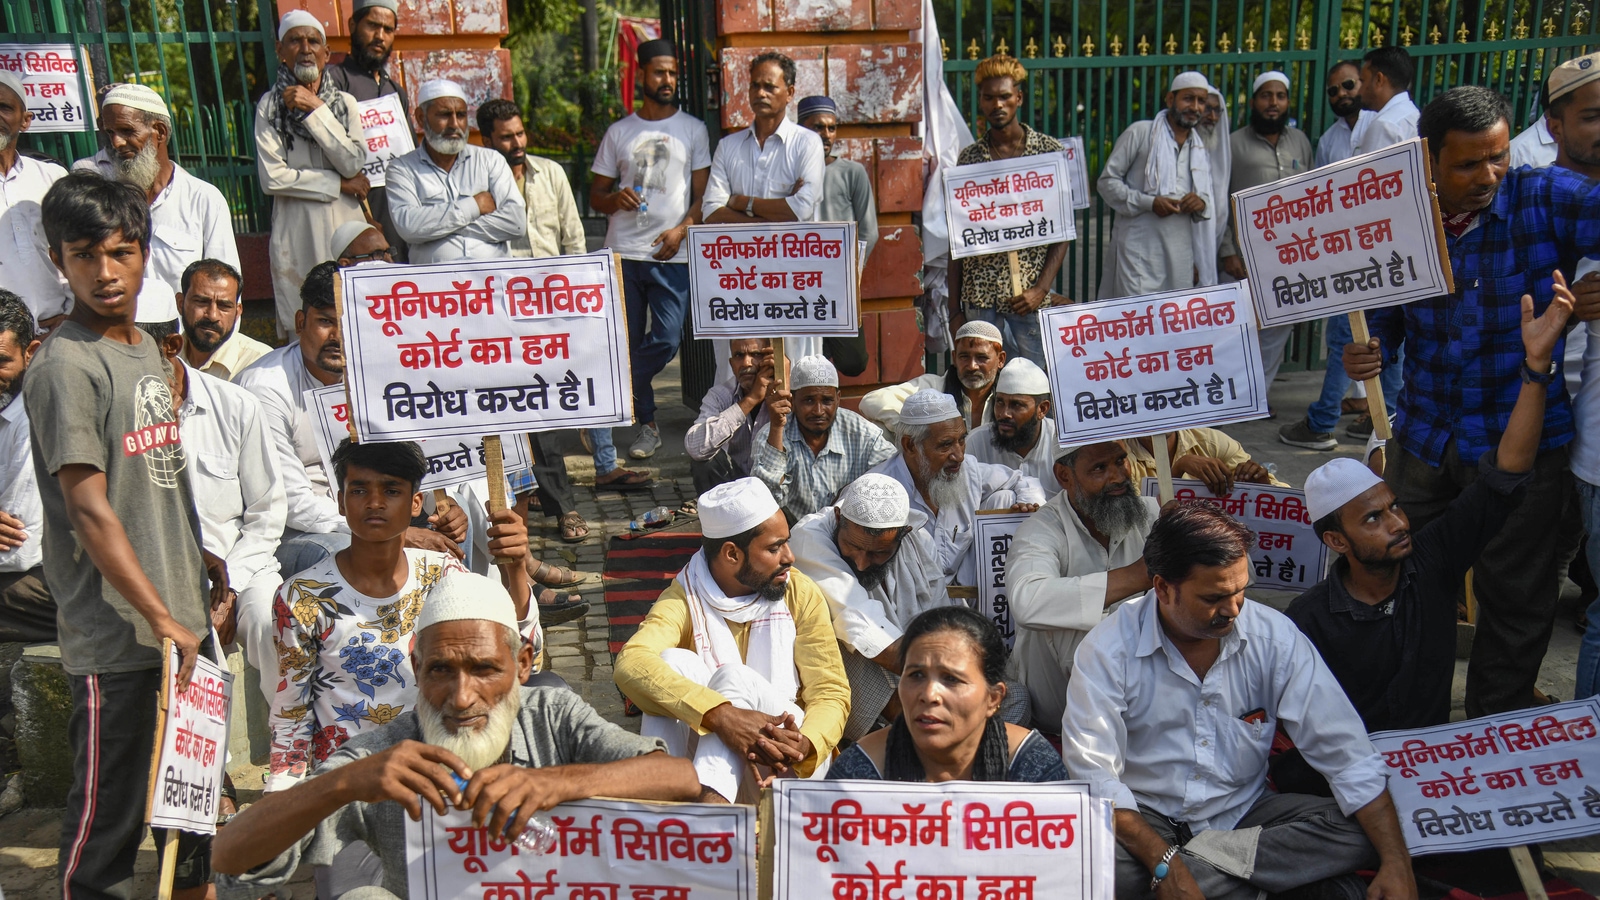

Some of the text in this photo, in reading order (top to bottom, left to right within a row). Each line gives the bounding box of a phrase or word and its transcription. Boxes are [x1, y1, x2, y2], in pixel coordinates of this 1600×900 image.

[24, 52, 79, 73] सिविल
[38, 82, 66, 98] हम
[366, 135, 389, 153] हम
[953, 171, 1054, 208] यूनिफॉर्म सिविल
[1252, 168, 1404, 241] यूनिफॉर्म सविल
[968, 199, 1044, 222] कोर्ट का हम
[701, 232, 842, 270] यूनिफॉर्म सिविल
[962, 226, 999, 248] विरोध
[1002, 220, 1034, 241] करते
[1276, 218, 1393, 266] कोर्ट का हम
[719, 265, 823, 290] कोर्ट का हम
[1272, 272, 1329, 310] विरोध
[1330, 256, 1383, 296] करते
[366, 273, 605, 337] यूनिफॉर्म सिविल
[709, 297, 759, 321] विरोध
[763, 296, 808, 319] करते
[1059, 297, 1236, 358] यूनिफॉर्म सिविल
[397, 328, 570, 370] कोर्ट का हम
[1083, 344, 1214, 382] कोर्ट का हम
[383, 380, 468, 421] विरोध
[475, 373, 549, 414] करते
[1074, 388, 1138, 423] विरोध
[1142, 378, 1200, 412] करते
[1258, 531, 1294, 551] हम
[203, 738, 217, 767] हम
[1382, 715, 1597, 779] यूनिफॉर्म सिविल
[163, 765, 189, 808] विरोध
[1417, 759, 1584, 799] कोर्ट का हम
[802, 799, 1077, 863] यूनिफॉर्म सिविल
[1412, 805, 1496, 838] विरोध
[1498, 790, 1576, 828] करते
[611, 818, 735, 864] सिविल
